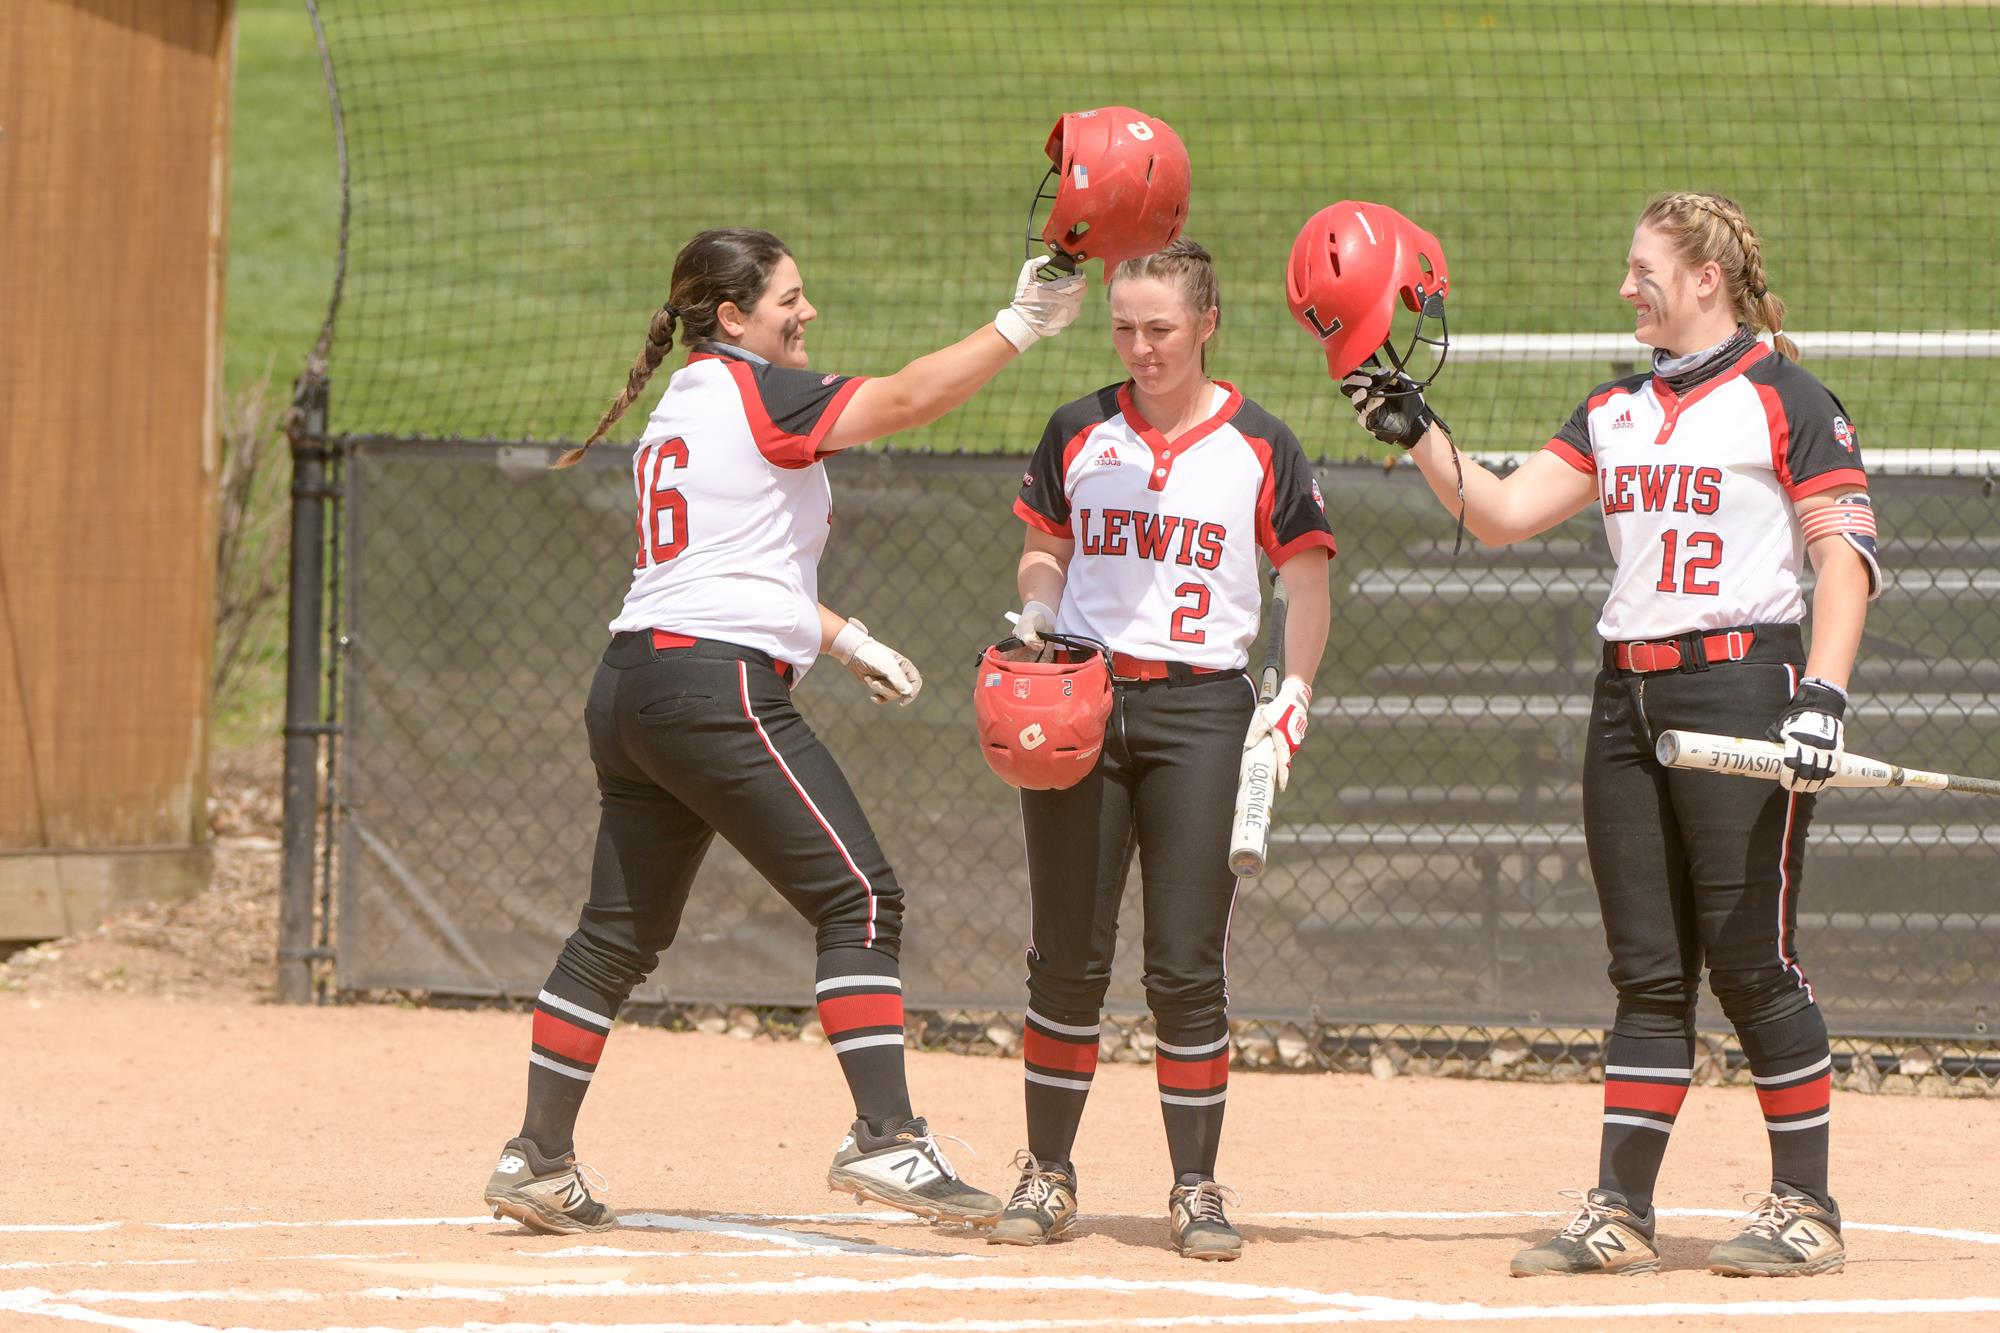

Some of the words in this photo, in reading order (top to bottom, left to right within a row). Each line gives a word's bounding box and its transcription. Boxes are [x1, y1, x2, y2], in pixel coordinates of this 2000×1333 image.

[1304, 305, 1343, 341] L
[636, 436, 690, 570] 16
[1601, 463, 1723, 516] LEWIS
[1080, 508, 1226, 570] LEWIS
[1656, 529, 1723, 596] 12
[1169, 582, 1211, 644] 2
[1709, 751, 1781, 774] UISVILLE
[1246, 763, 1270, 828] LOUISVILLE
